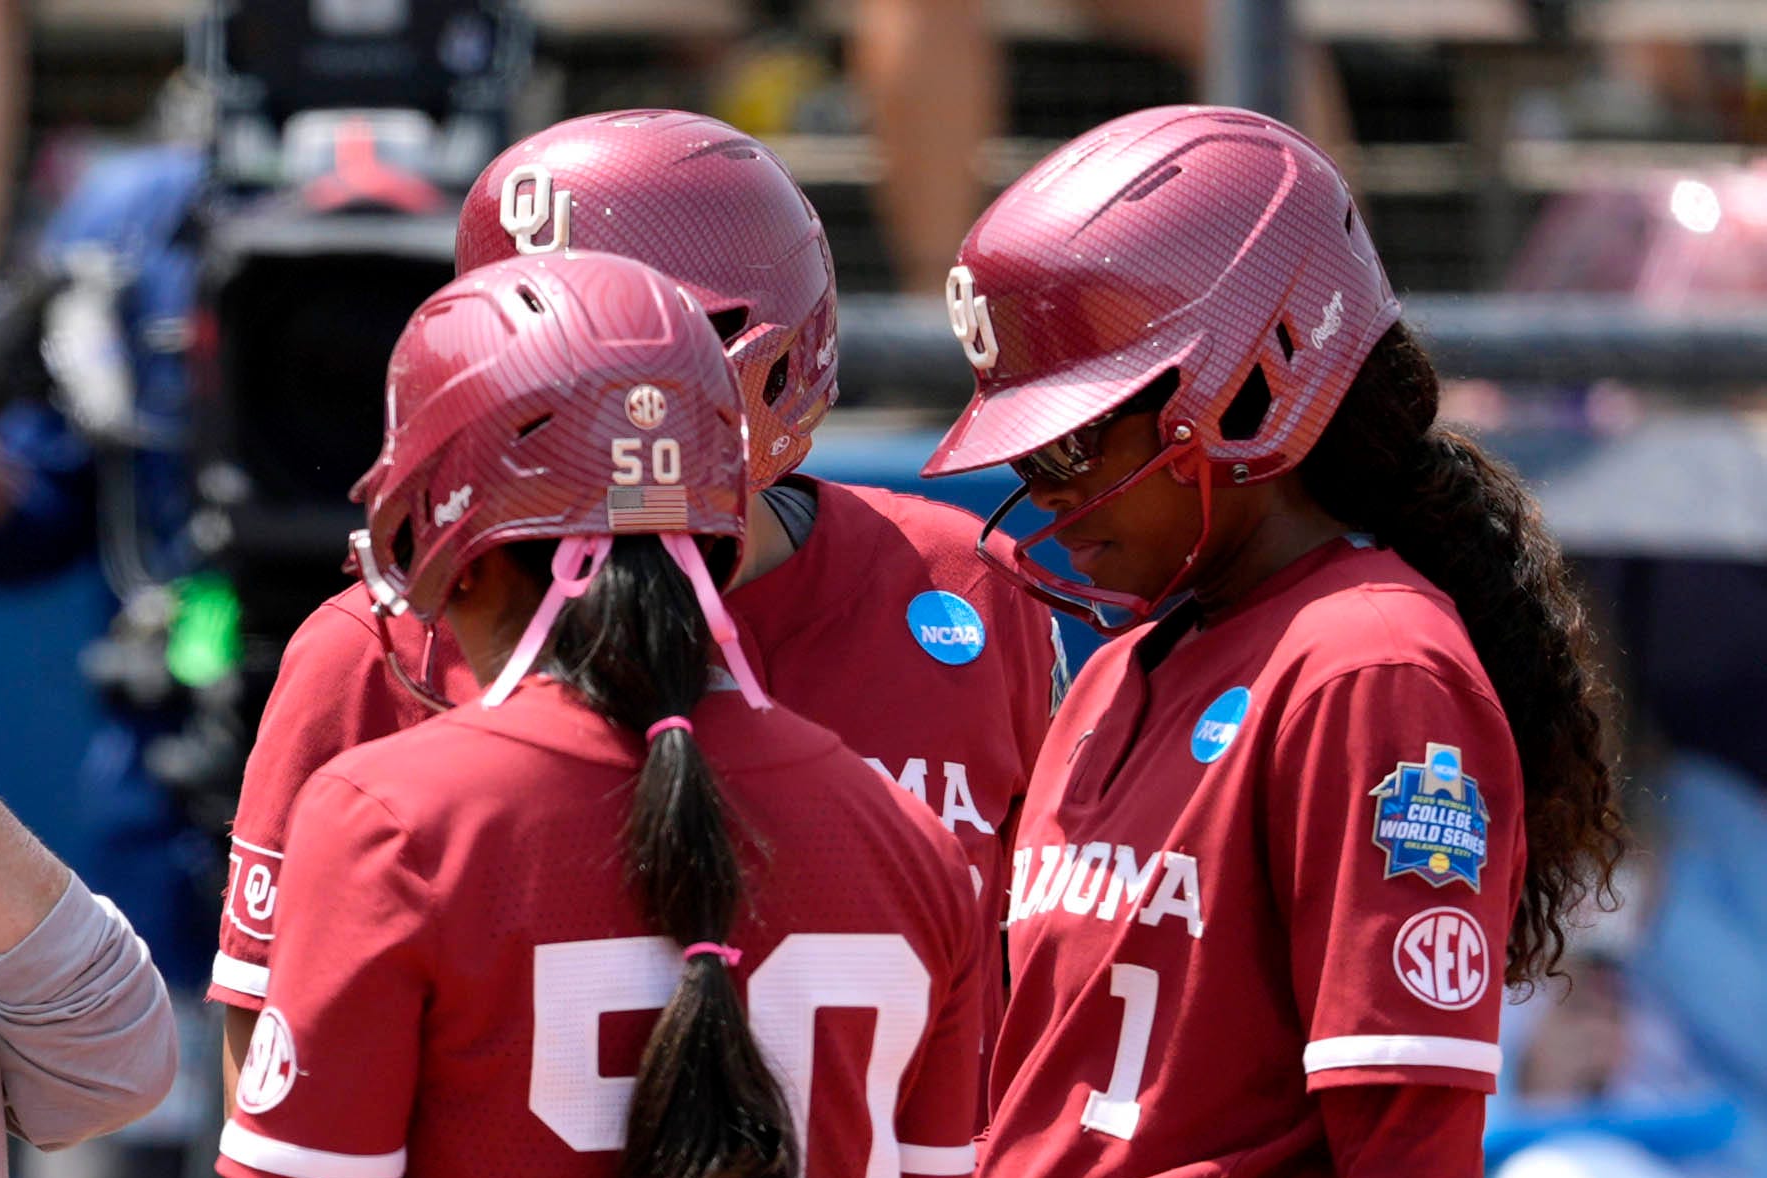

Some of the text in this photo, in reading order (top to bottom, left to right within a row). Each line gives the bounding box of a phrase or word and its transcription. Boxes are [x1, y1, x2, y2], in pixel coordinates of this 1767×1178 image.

[499, 163, 571, 255] OU
[944, 265, 999, 369] OU
[611, 437, 681, 485] 50
[920, 624, 979, 645] NCAA
[1379, 820, 1487, 857] WORLD SERIES
[1407, 803, 1472, 831] COLLEGE
[243, 864, 278, 921] OU
[1401, 914, 1482, 1002] SEC
[1080, 963, 1160, 1141] 1
